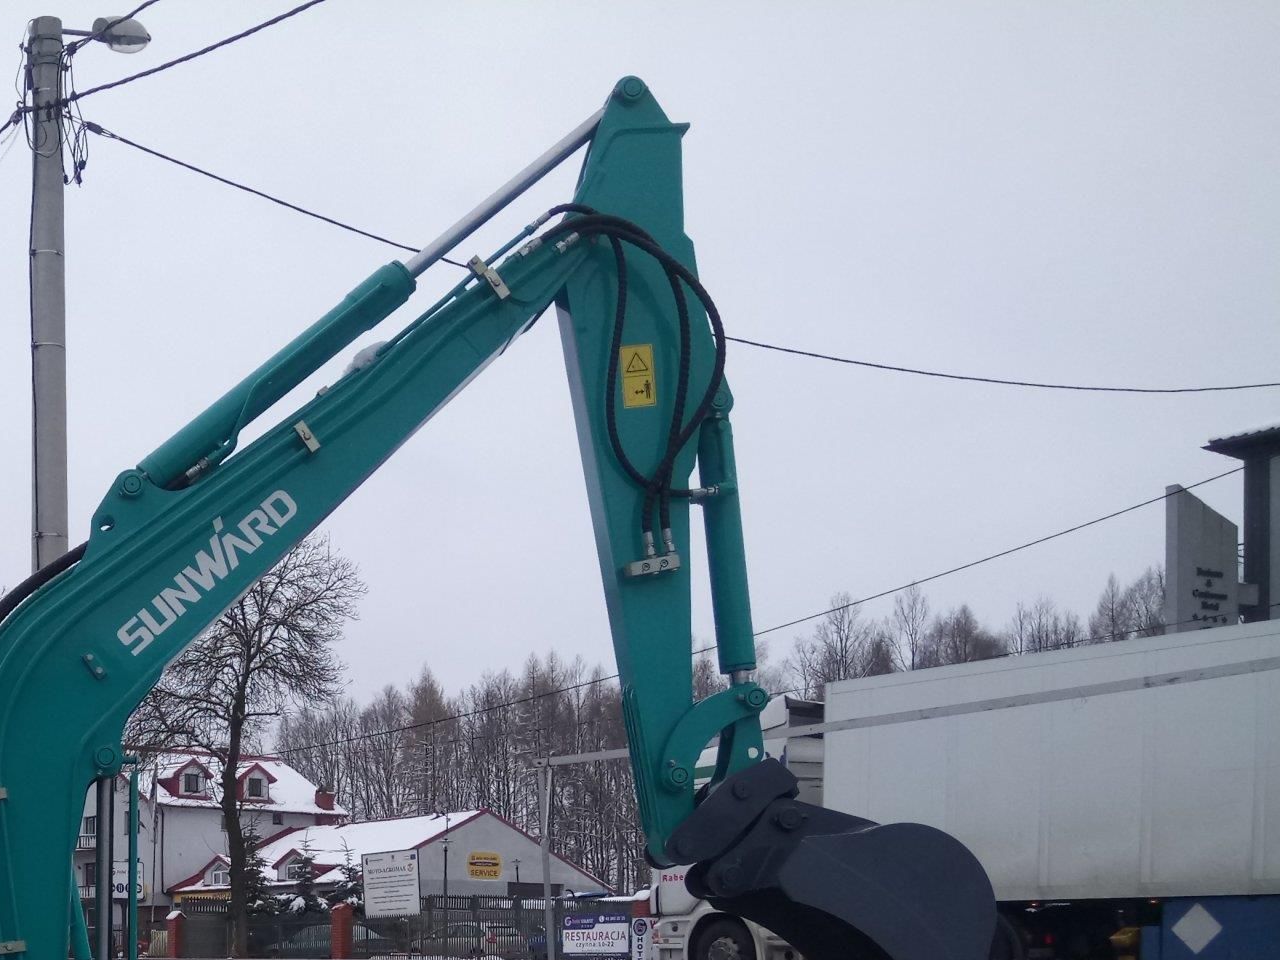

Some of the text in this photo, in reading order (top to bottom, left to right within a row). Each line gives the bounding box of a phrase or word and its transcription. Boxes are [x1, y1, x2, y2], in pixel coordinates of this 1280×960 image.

[117, 489, 298, 656] SUNWARD
[470, 869, 499, 877] SERVICE
[564, 930, 627, 941] RESTAURACJA
